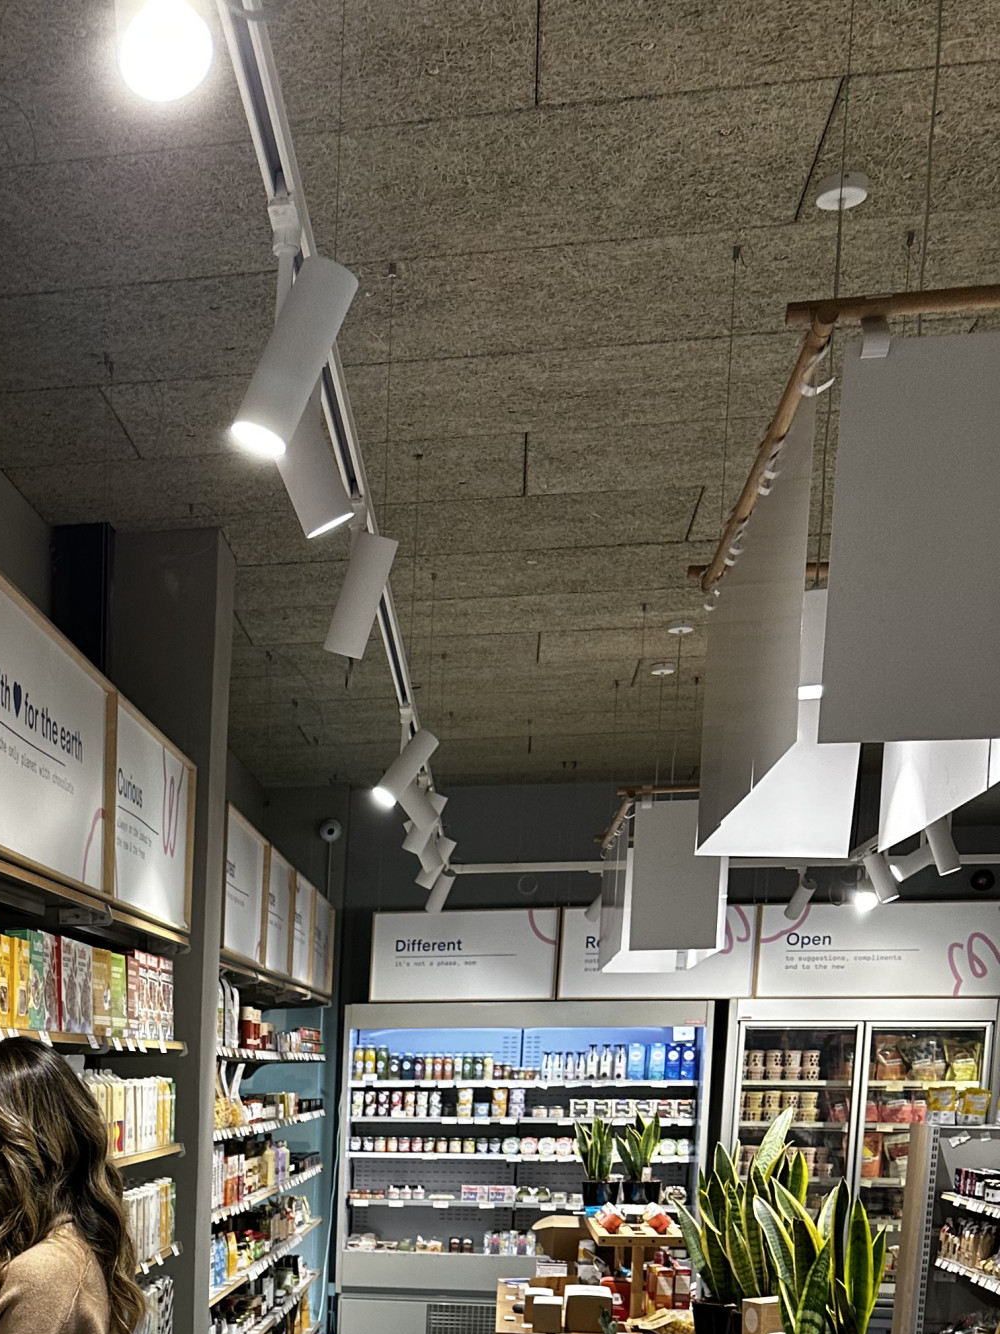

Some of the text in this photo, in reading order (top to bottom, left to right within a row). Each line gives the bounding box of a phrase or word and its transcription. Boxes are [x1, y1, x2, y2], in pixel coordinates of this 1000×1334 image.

[24, 692, 40, 733] for
[41, 707, 59, 746] the
[60, 726, 83, 764] earth
[117, 767, 143, 809] Curious
[394, 938, 463, 953] Different
[786, 932, 832, 949] Open
[413, 960, 427, 968] not
[853, 954, 902, 964] compliments
[784, 963, 799, 971] and
